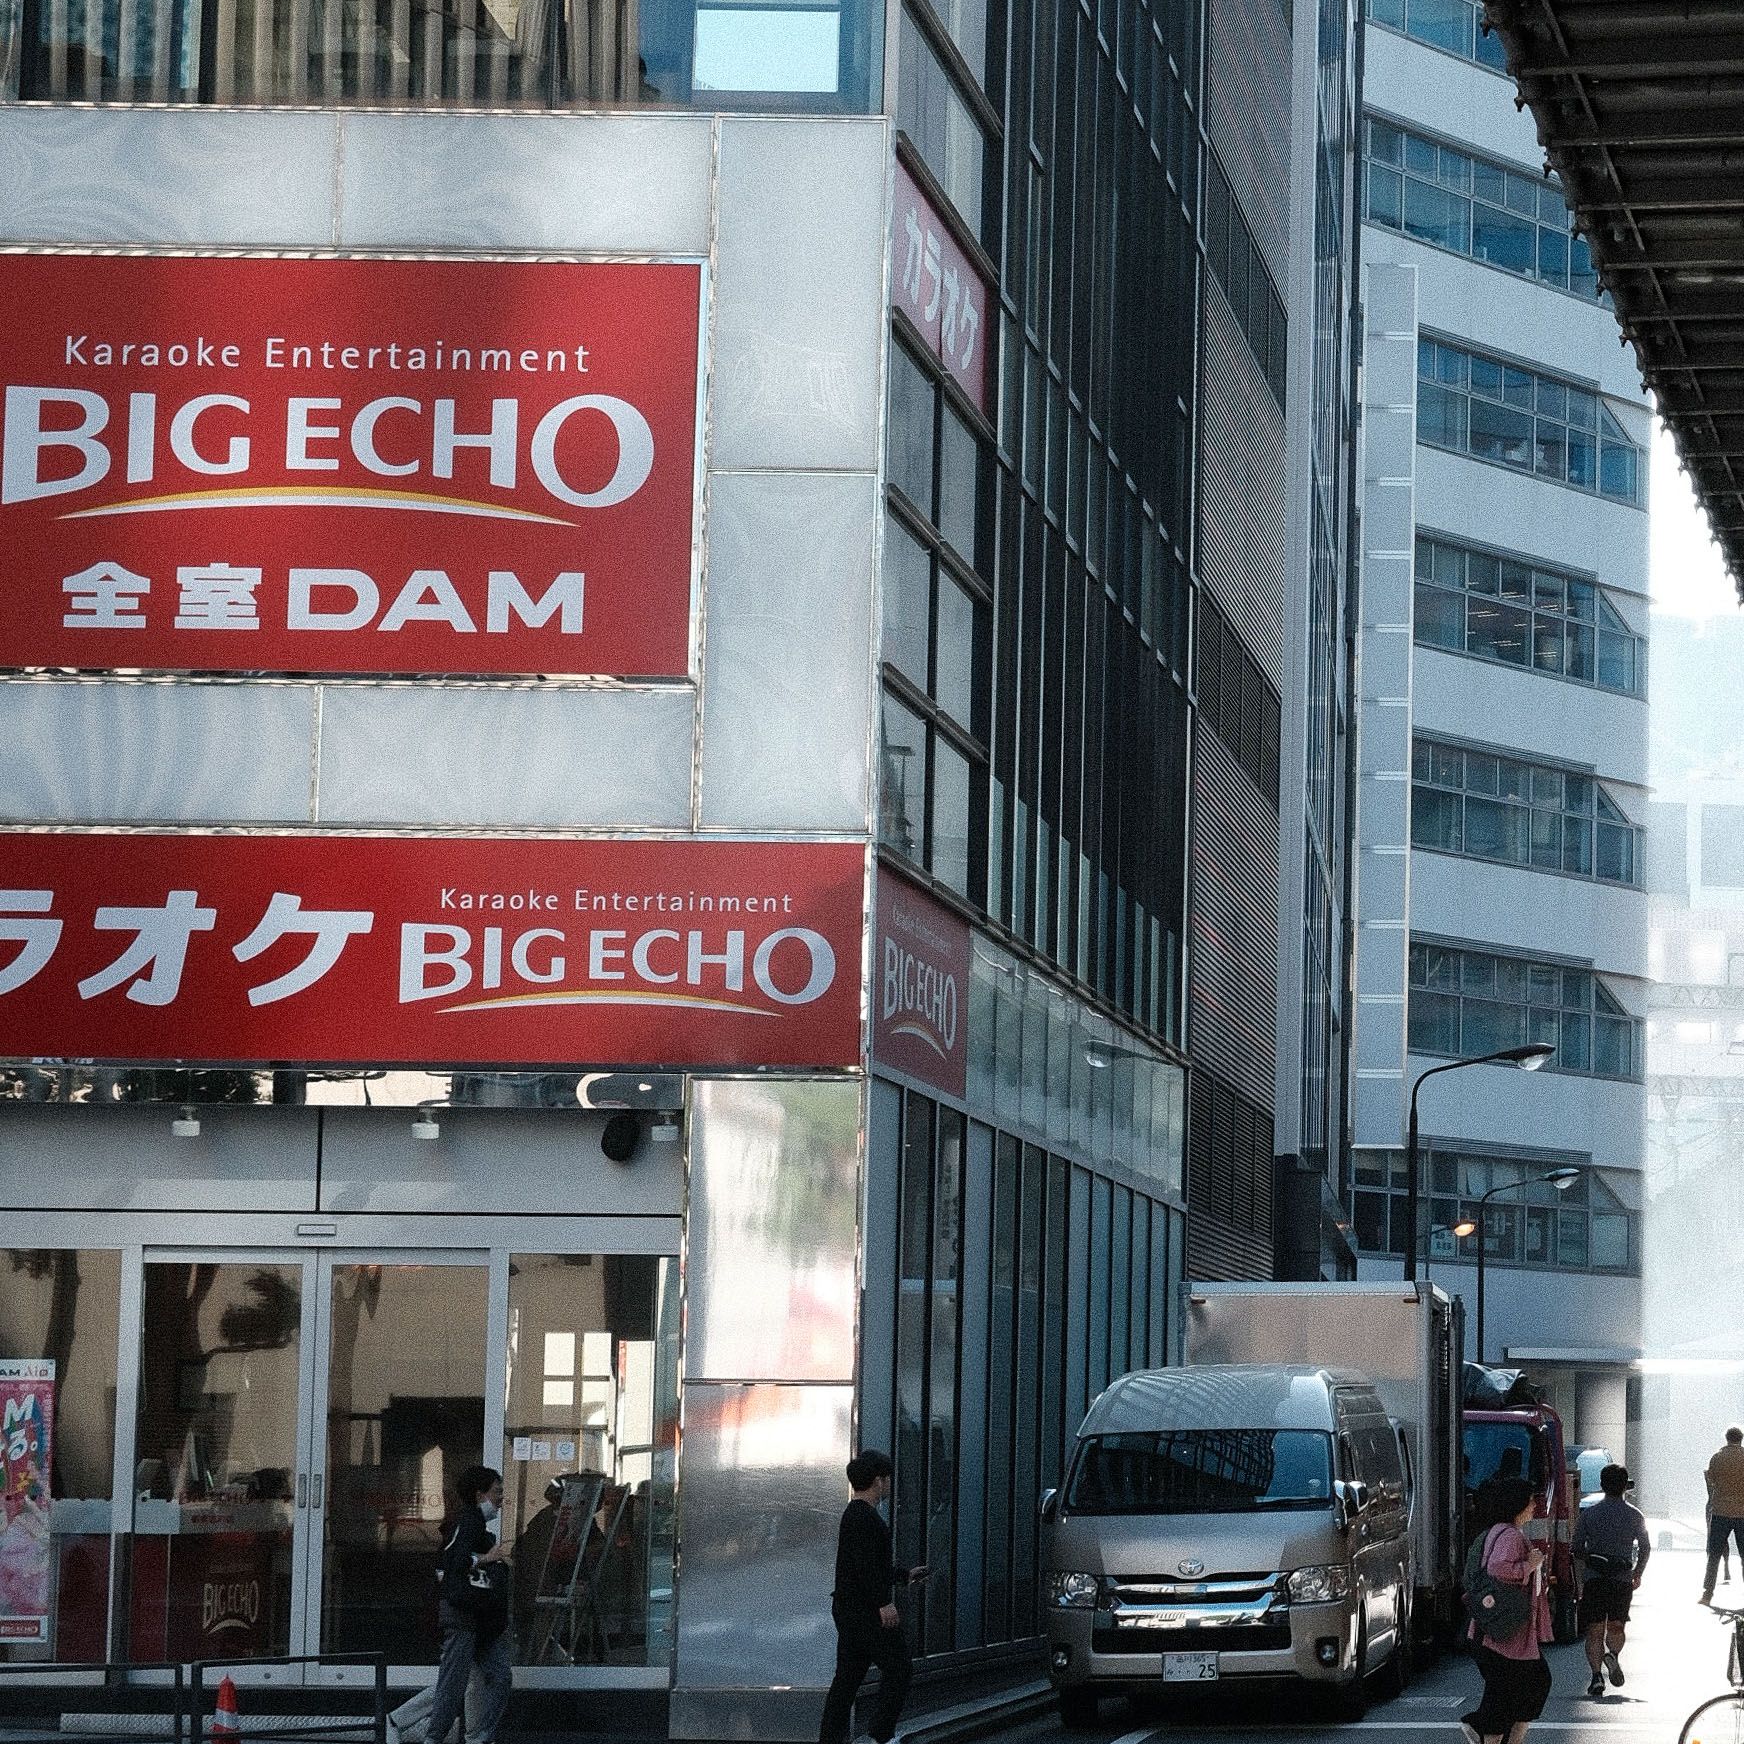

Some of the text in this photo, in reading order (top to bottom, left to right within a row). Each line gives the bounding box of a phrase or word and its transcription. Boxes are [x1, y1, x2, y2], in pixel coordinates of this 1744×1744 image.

[903, 206, 979, 371] カラオケ
[65, 335, 591, 373] Karaoke Entertainment
[2, 385, 655, 508] BIG ECHO
[440, 888, 793, 913] Karaoke Entertainment
[399, 922, 565, 1003] BIG
[590, 927, 835, 1004] ECHO
[883, 936, 957, 1050] BIG ECHO
[203, 1580, 260, 1629] BIG ECHO
[1199, 1664, 1216, 1678] 25
